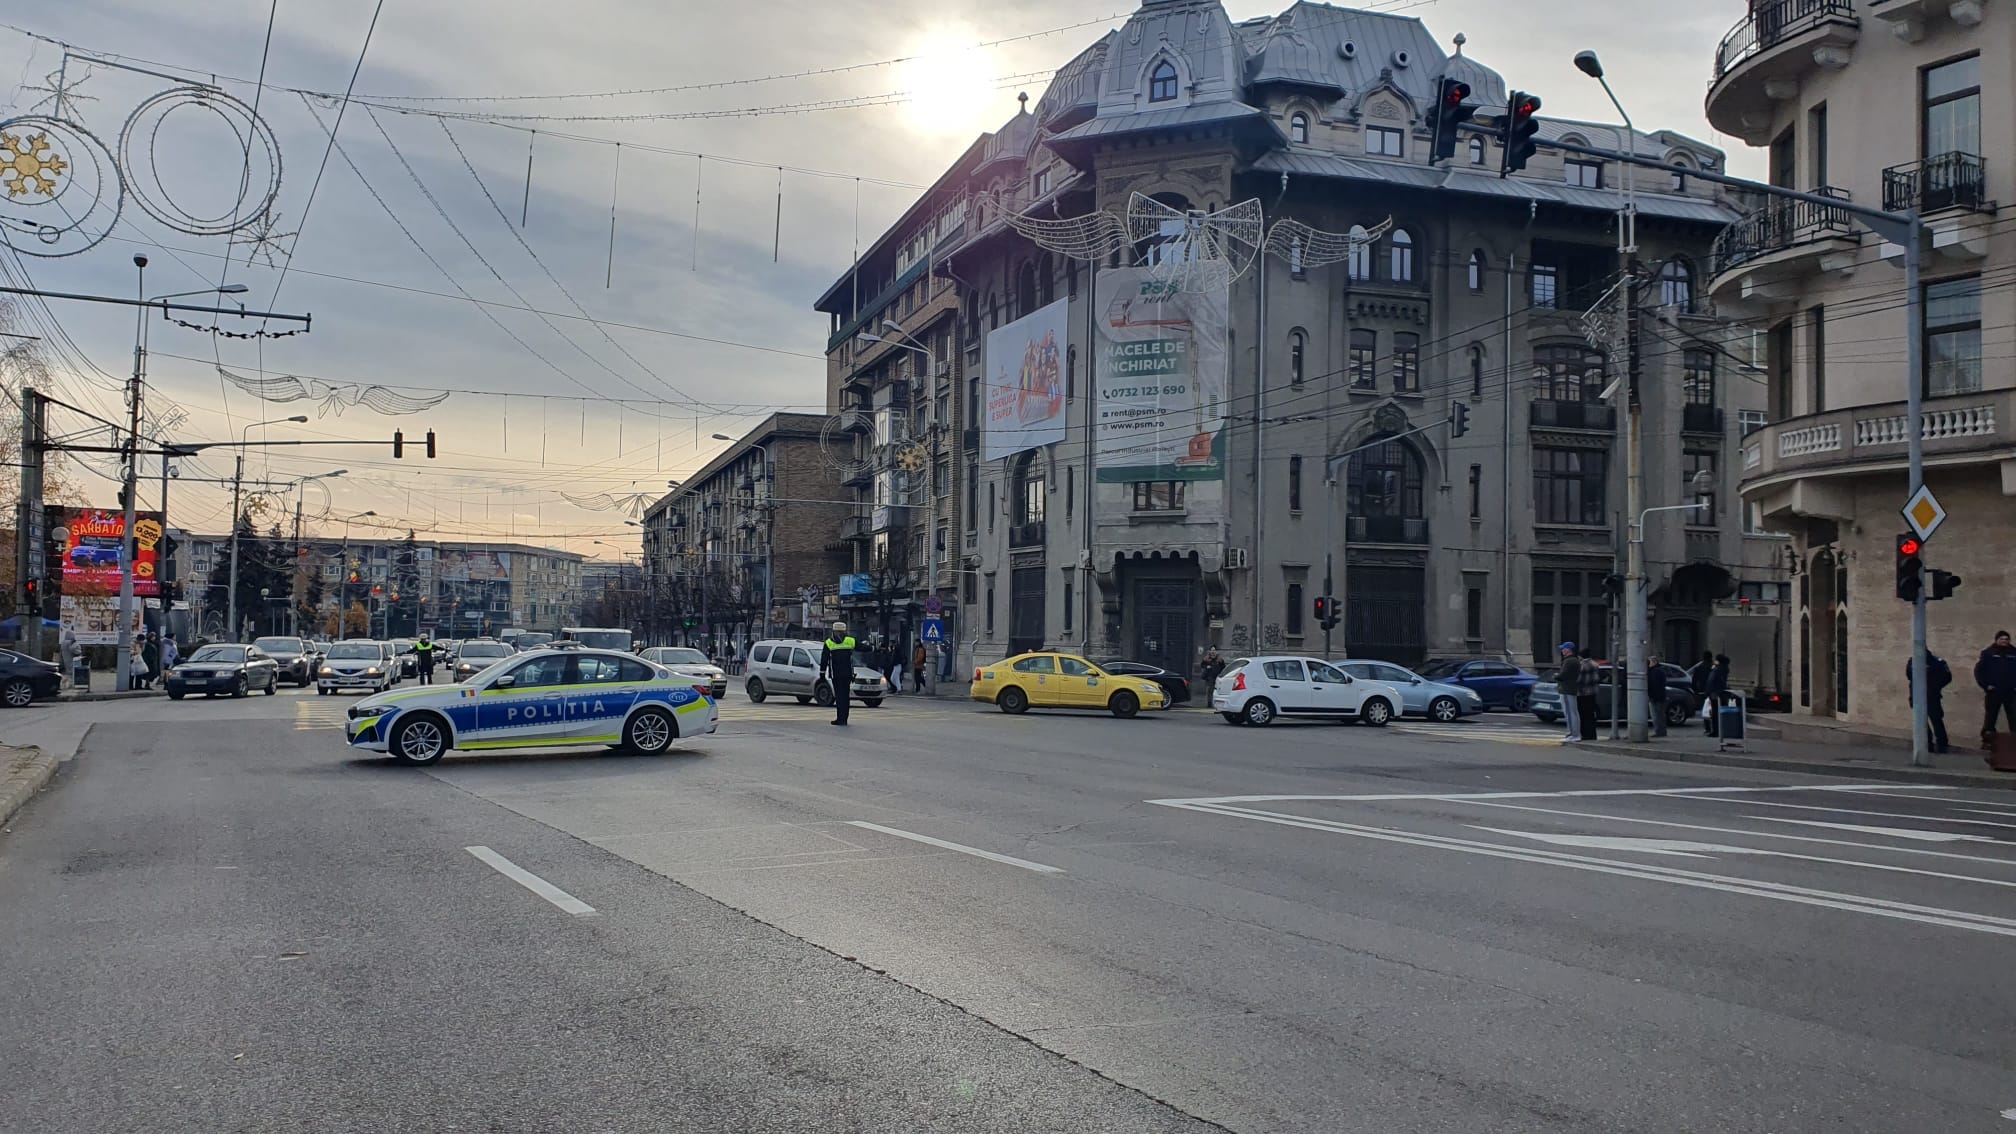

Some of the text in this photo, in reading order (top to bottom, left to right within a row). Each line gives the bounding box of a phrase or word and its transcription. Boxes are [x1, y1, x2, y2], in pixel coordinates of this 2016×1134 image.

[1164, 341, 1185, 354] DE
[1105, 358, 1177, 373] NCHIRIAT
[1111, 384, 1186, 398] 0732 123 690
[1110, 408, 1167, 418] rent@psm.ro
[1110, 421, 1165, 430] www.psm.ro
[507, 699, 606, 721] POLITIA
